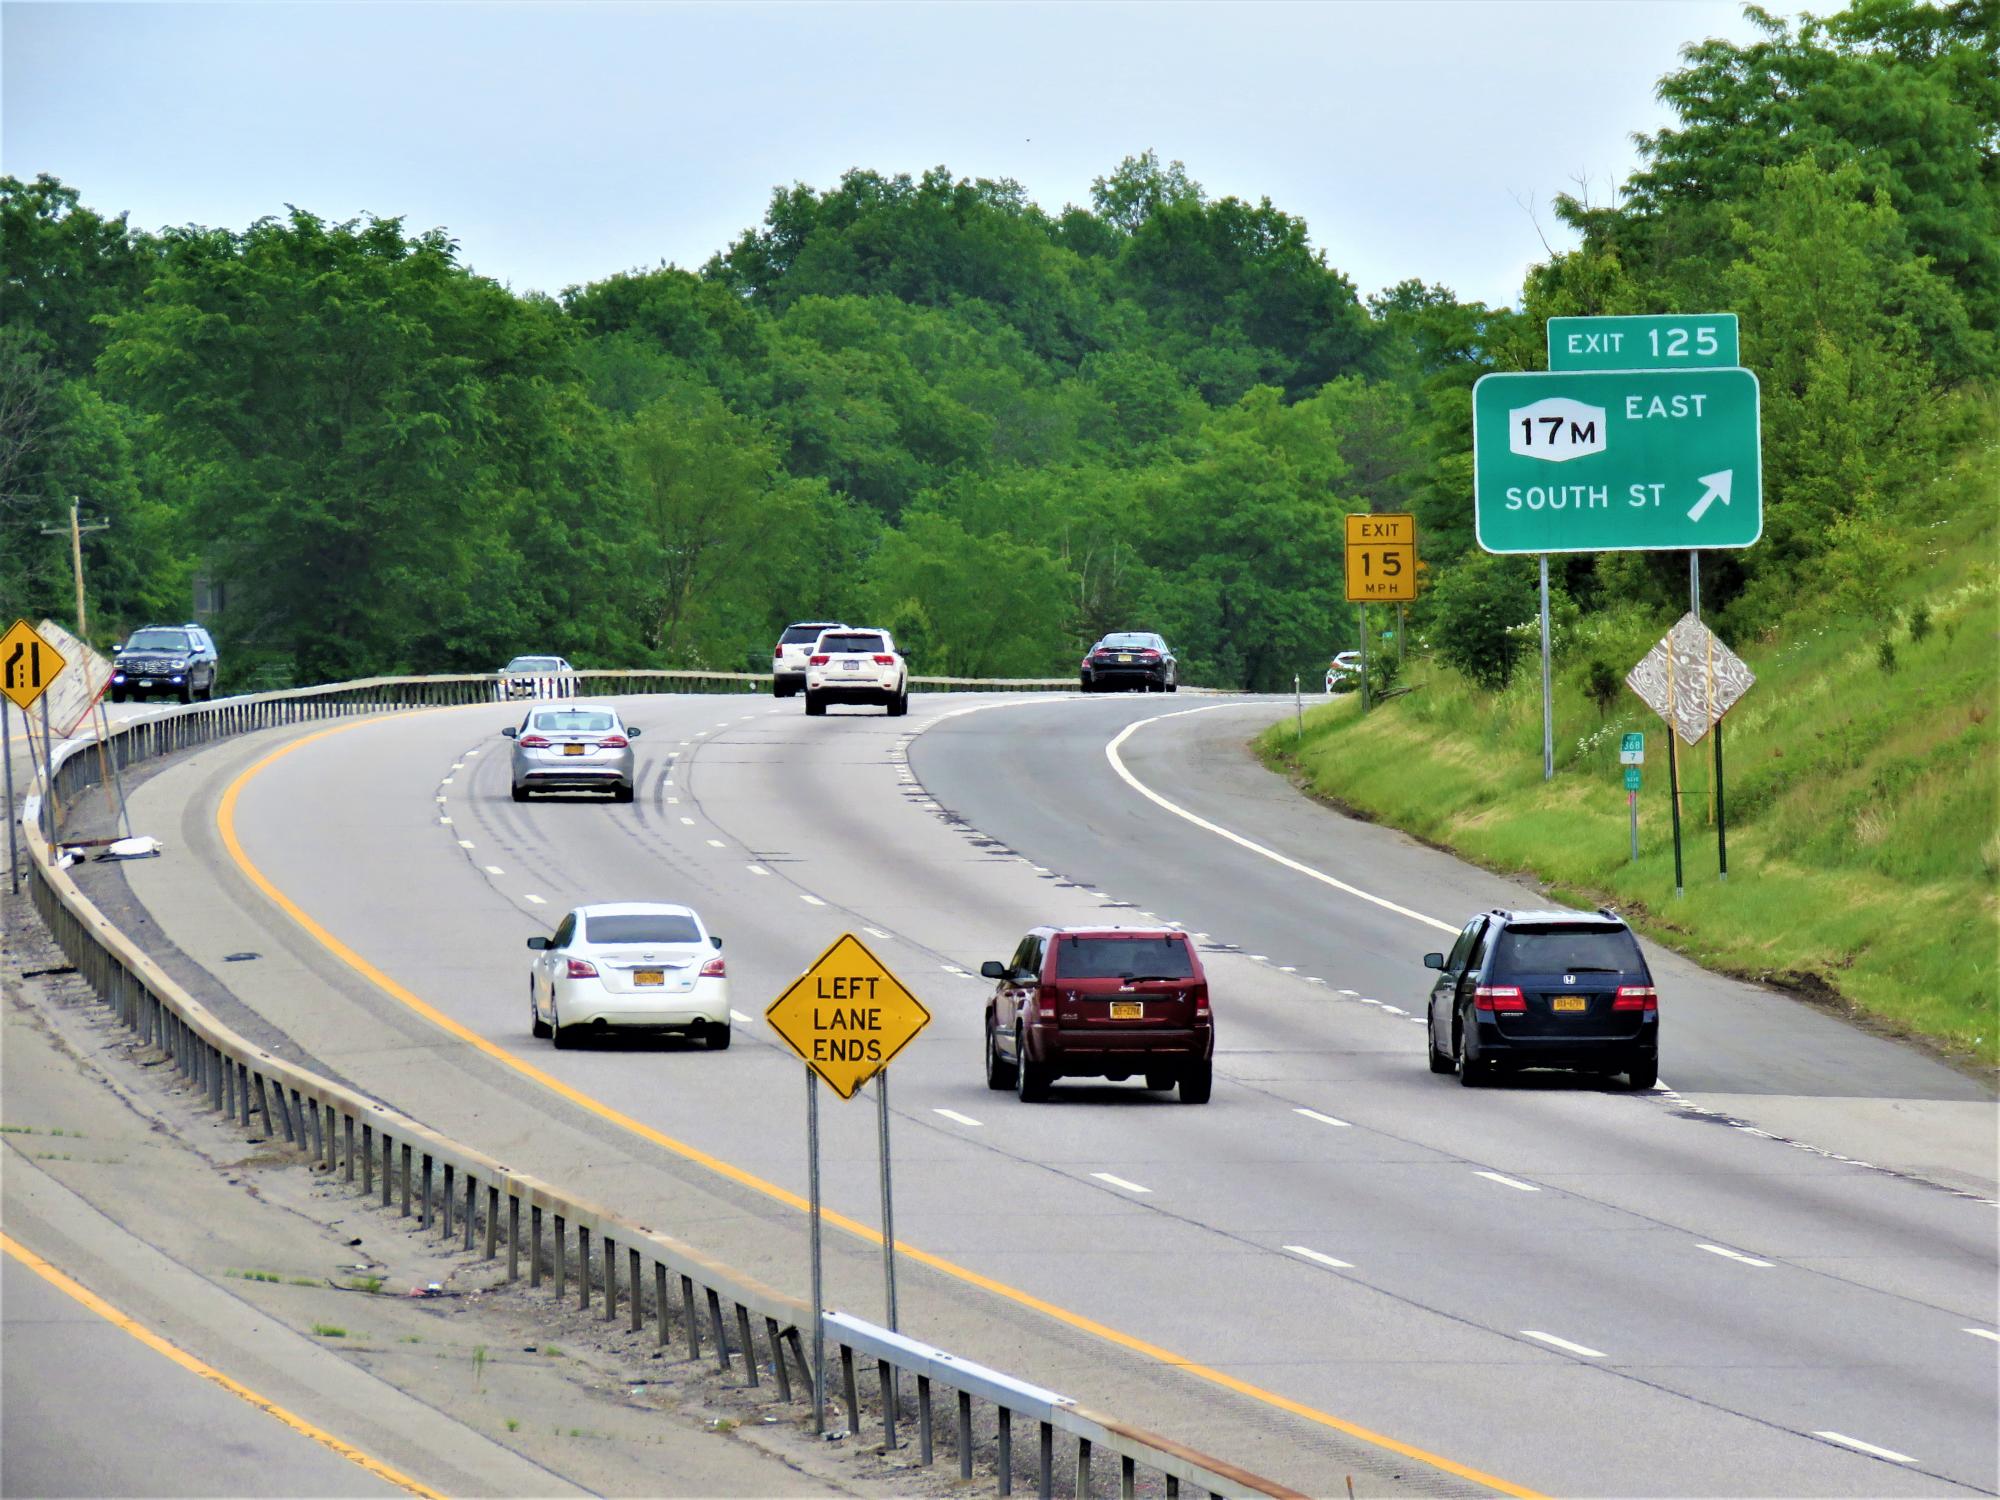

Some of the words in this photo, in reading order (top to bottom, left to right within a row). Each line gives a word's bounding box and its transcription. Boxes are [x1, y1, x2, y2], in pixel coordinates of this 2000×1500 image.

[1567, 333, 1624, 354] EXIT
[1649, 327, 1718, 357] 125
[1626, 394, 1707, 419] EAST
[1521, 416, 1596, 445] 17M
[1505, 485, 1608, 510] SOUTH
[1629, 484, 1665, 507] ST
[1362, 524, 1399, 536] EXIT
[1362, 552, 1401, 576] 15
[1366, 584, 1397, 593] MPH
[1624, 741, 1640, 750] 368
[817, 976, 879, 999] LEFT
[814, 1008, 882, 1030] LANE
[813, 1039, 882, 1062] ENDS
